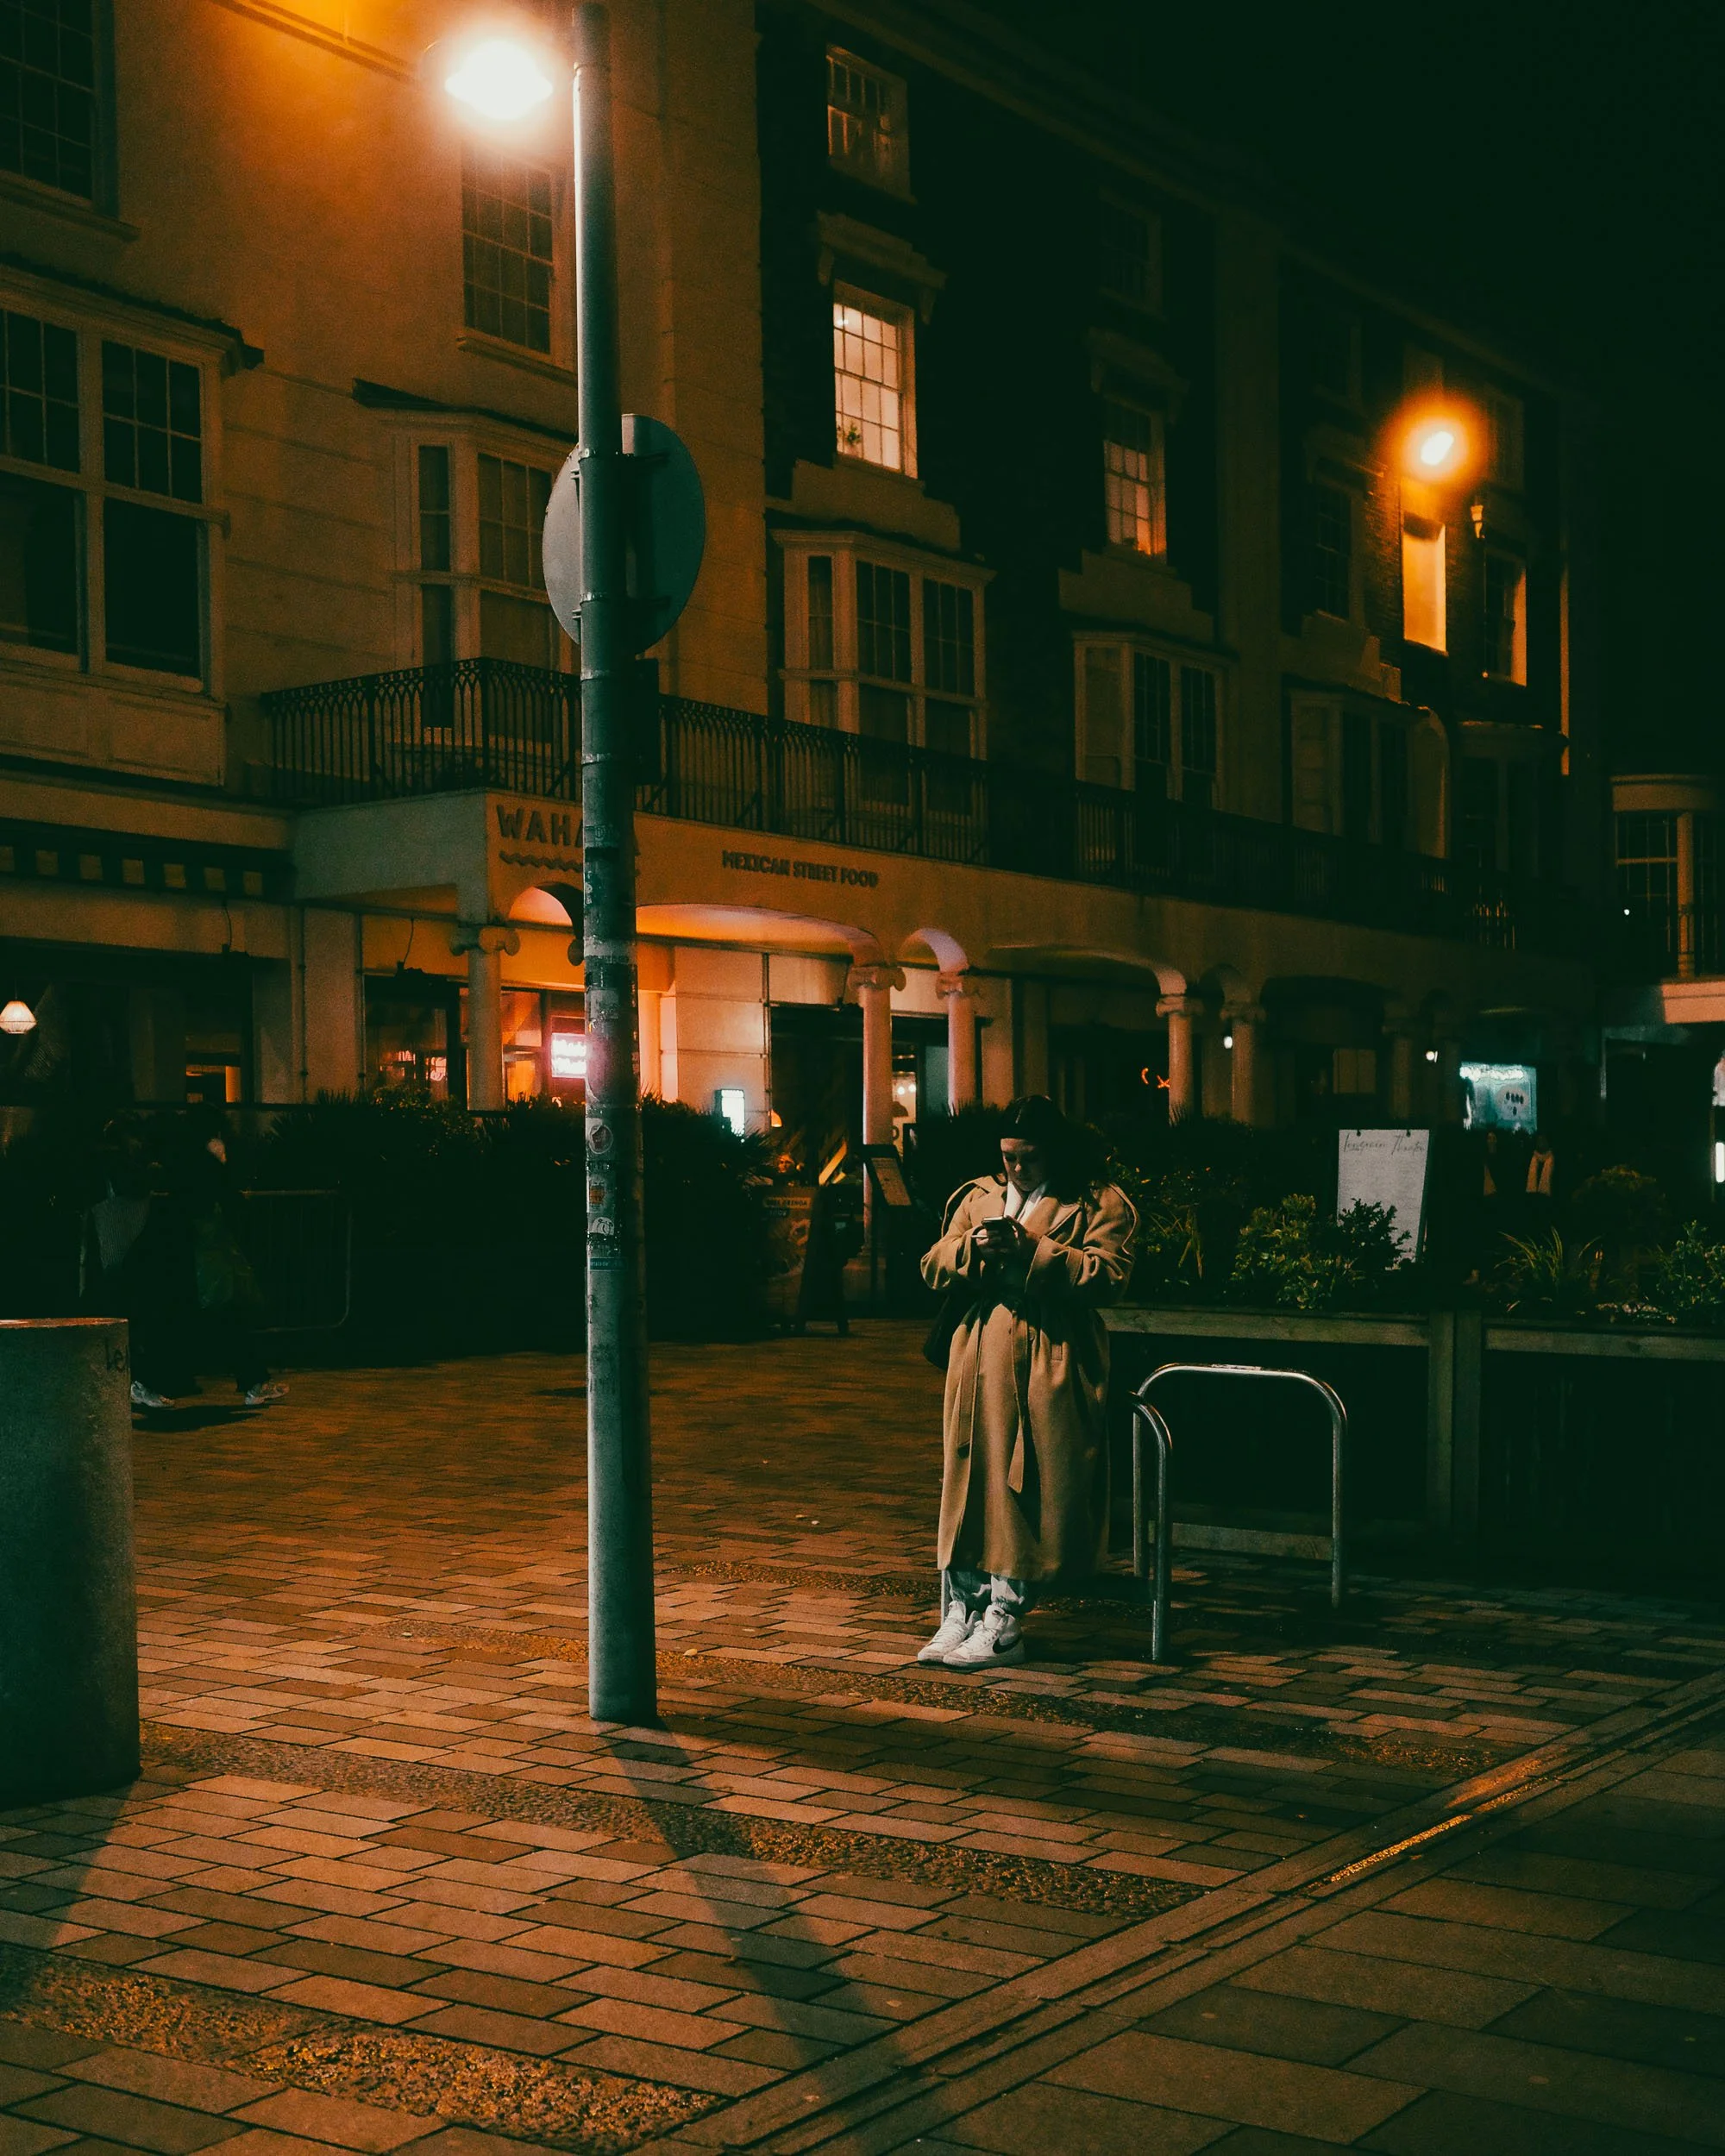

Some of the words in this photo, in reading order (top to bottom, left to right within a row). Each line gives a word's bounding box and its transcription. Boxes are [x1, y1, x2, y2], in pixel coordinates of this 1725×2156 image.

[722, 849, 790, 876] MEXICAN
[792, 861, 837, 883] STREET
[840, 866, 879, 887] FOOD
